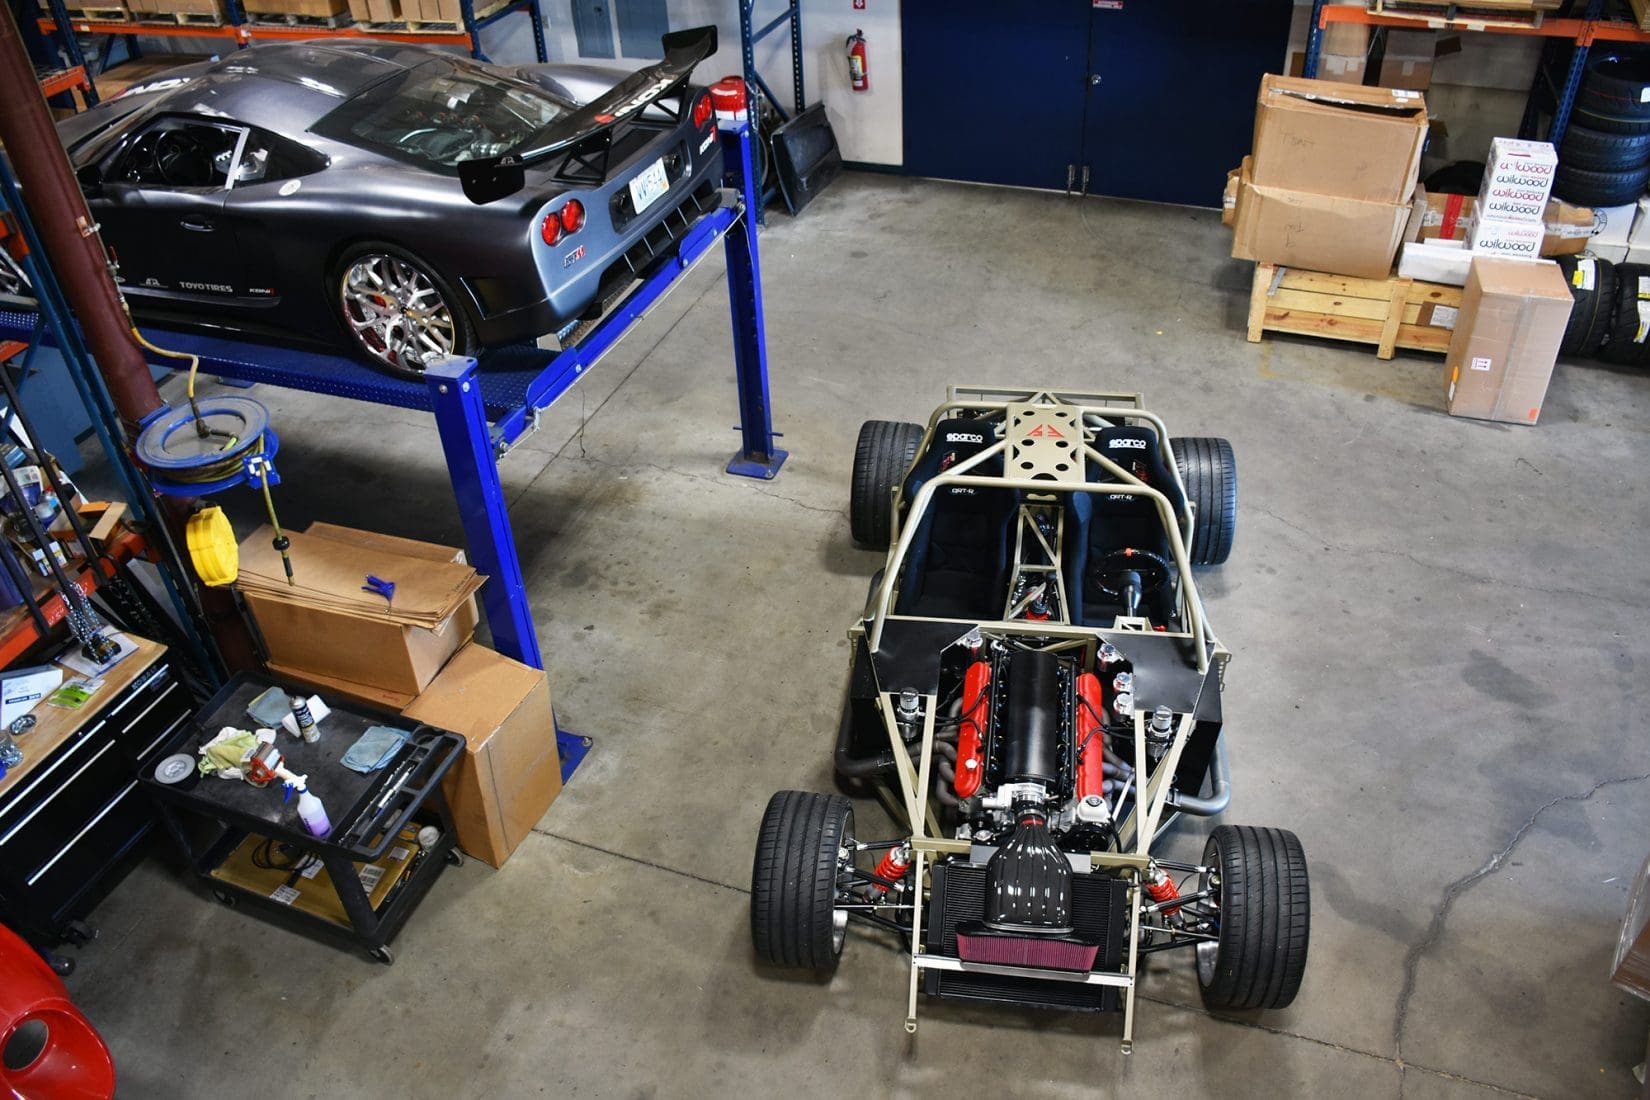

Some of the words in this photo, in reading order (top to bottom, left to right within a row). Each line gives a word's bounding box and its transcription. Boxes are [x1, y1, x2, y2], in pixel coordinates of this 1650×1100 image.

[1496, 174, 1549, 188] wilwood
[1492, 187, 1545, 202] wilwood
[1489, 201, 1541, 215] wilwood
[1480, 238, 1536, 252] wilwood
[179, 281, 205, 290] TOYO
[205, 283, 234, 293] TIRES
[946, 432, 984, 443] sparco
[1108, 438, 1147, 449] sparco
